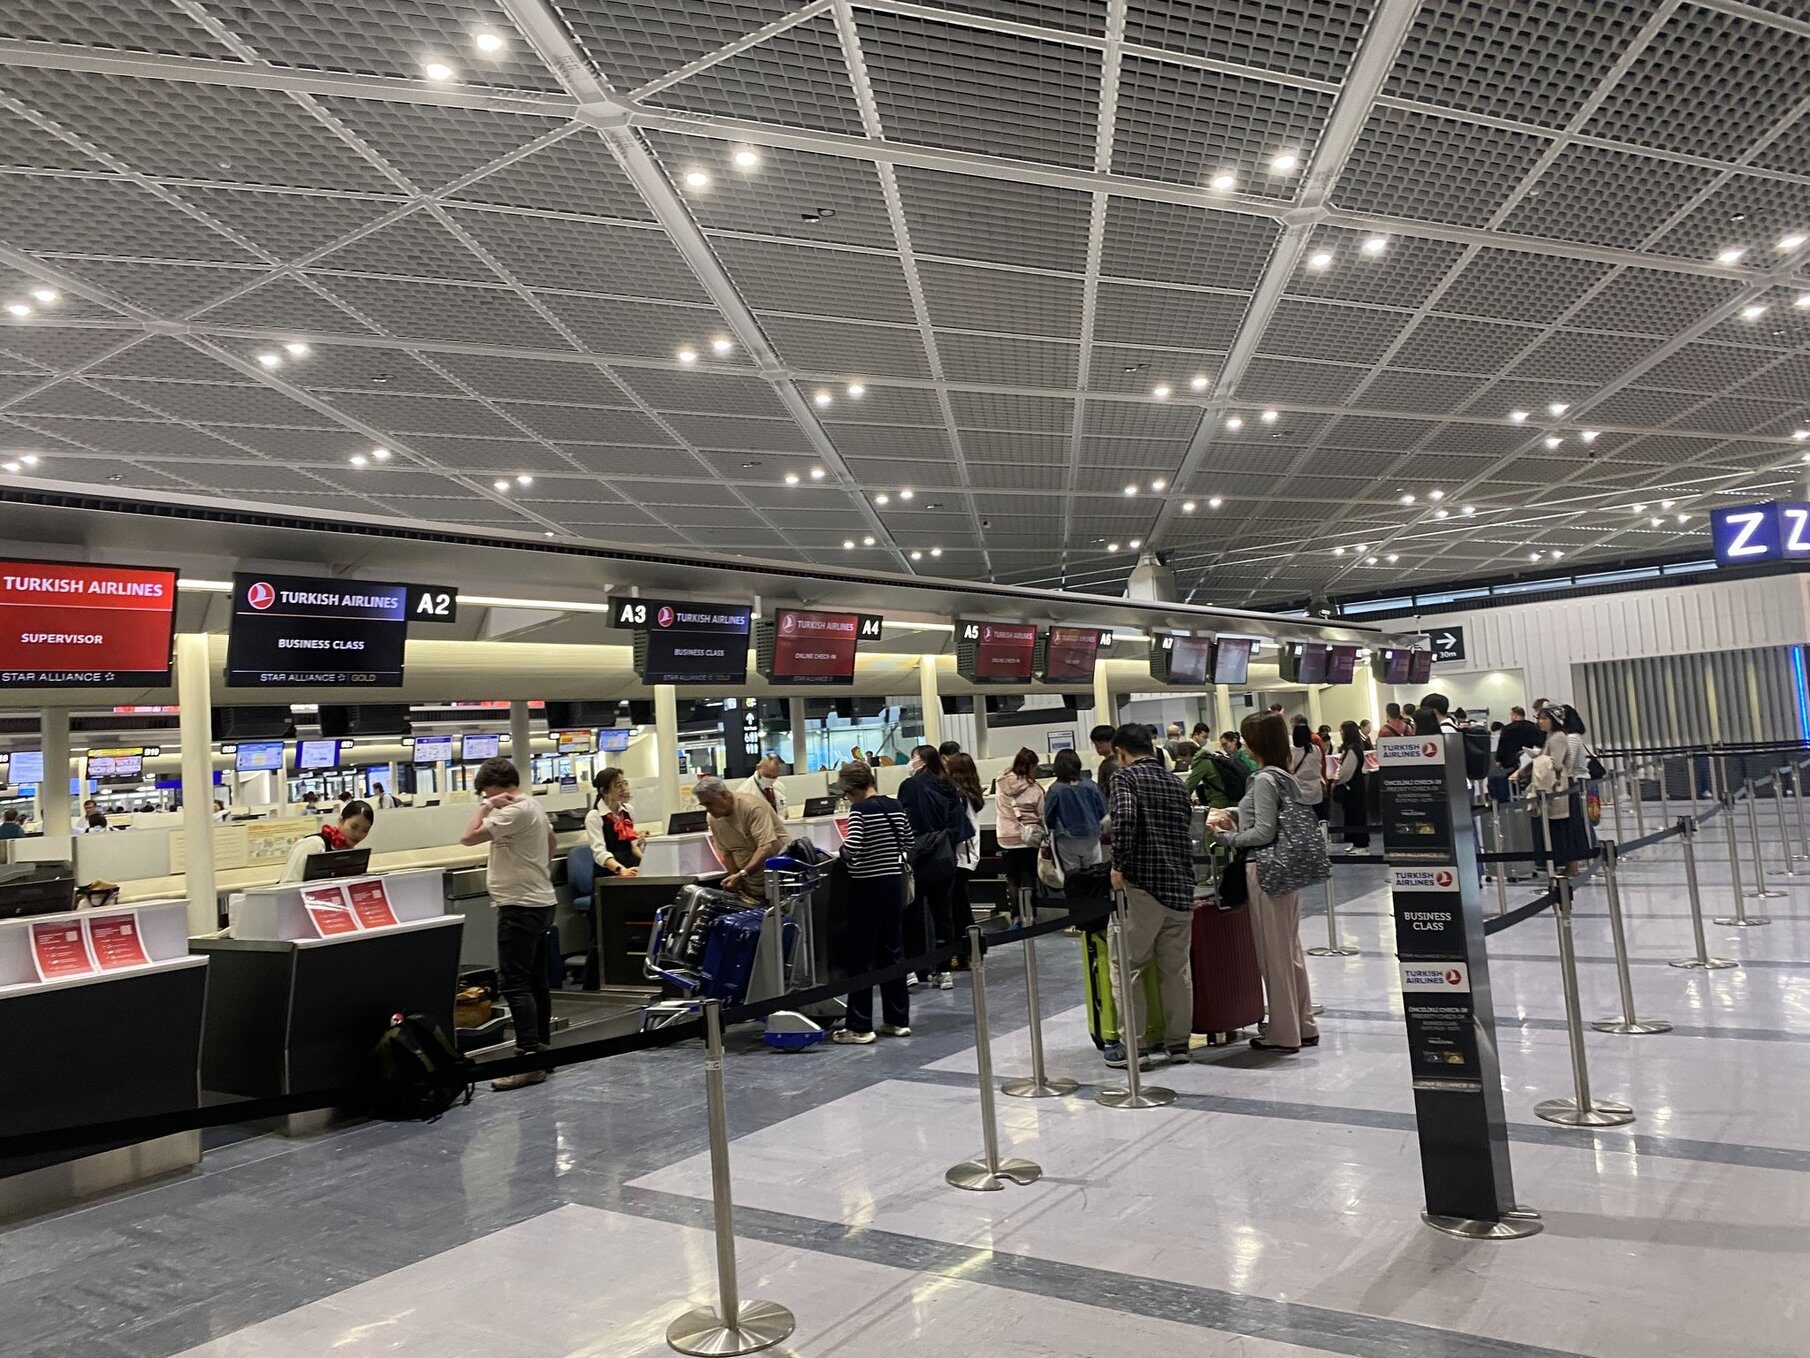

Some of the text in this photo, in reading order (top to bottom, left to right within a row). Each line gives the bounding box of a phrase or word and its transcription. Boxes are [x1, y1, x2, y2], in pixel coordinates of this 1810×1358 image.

[1726, 512, 1768, 556] Z
[1785, 510, 1810, 550] Z
[4, 576, 163, 597] TURKISH AIRLINES
[280, 591, 398, 609] TURKISH AIRLINES
[417, 593, 450, 615] A2
[620, 604, 646, 624] A3
[676, 613, 745, 625] TURKISH AIRLINES
[798, 620, 854, 631] TURKISH AIRLINES
[862, 620, 879, 636] A4
[964, 625, 979, 639] A5
[993, 631, 1033, 640] TURKISH AIRLINES
[21, 633, 103, 645] SUPERVISOR
[278, 638, 364, 650] BUSINESS CLASS
[1100, 633, 1111, 646] A6
[674, 648, 724, 657] BUSINESS CLASS
[1439, 651, 1457, 659] 30m
[1, 672, 103, 683] STAR ALLIANCE
[260, 673, 376, 683] STAR ALLIANCE GOLD
[1382, 743, 1420, 751] TURKISH
[1404, 912, 1452, 921] BUSINESS
[1413, 922, 1444, 931] CLASS
